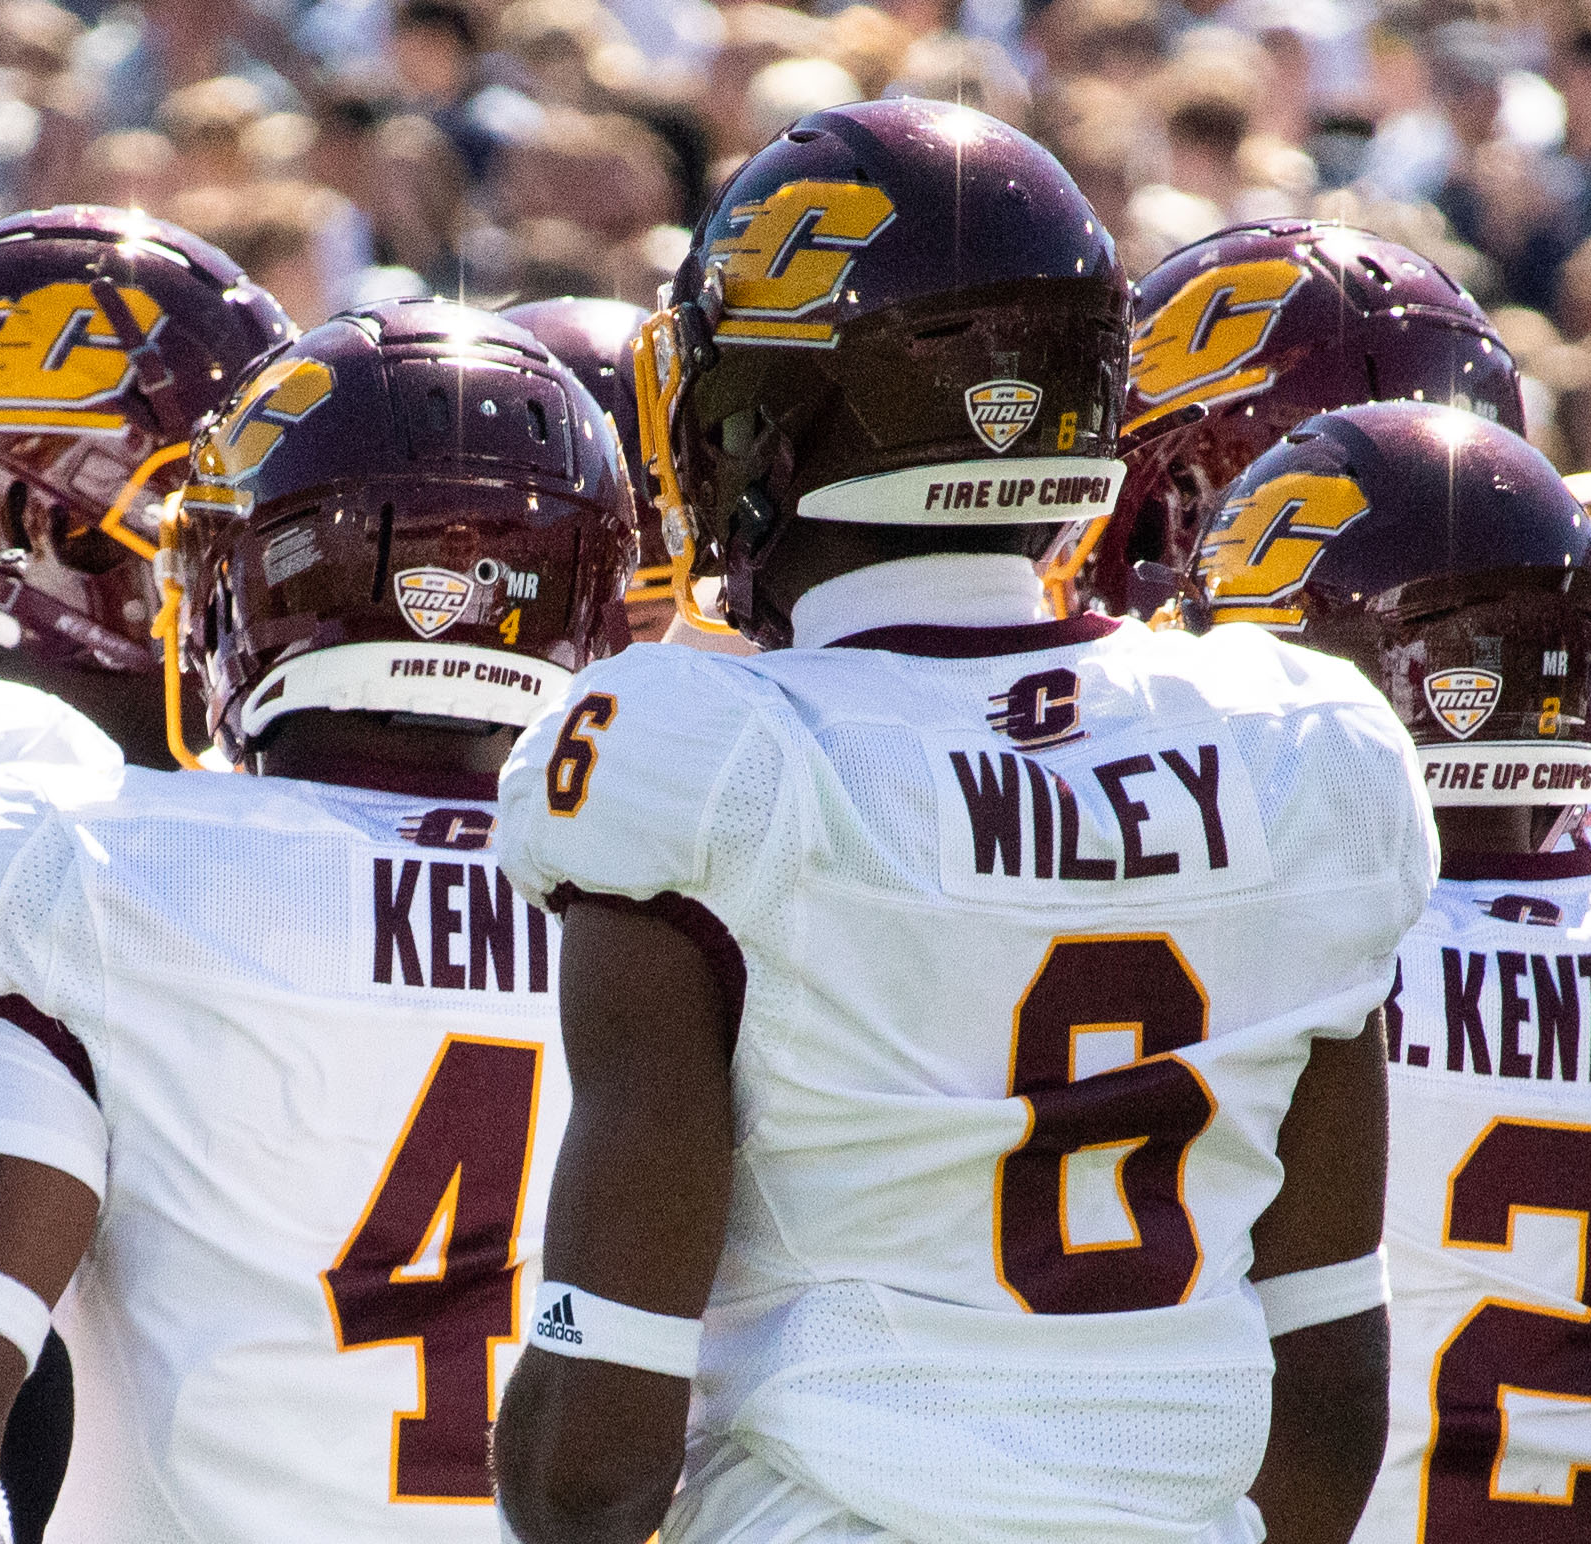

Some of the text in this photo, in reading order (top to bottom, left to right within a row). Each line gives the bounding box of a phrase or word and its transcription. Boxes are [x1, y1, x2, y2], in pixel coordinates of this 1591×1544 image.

[975, 404, 1035, 421] MAC
[925, 480, 993, 510] FIRE
[997, 478, 1035, 506] UP
[506, 572, 539, 600] MR
[401, 589, 463, 611] MAC
[499, 608, 522, 645] 4
[390, 659, 438, 677] FIRE
[442, 660, 471, 678] UP
[1542, 650, 1568, 676] MR
[1434, 690, 1494, 709] MAC
[1538, 697, 1561, 734] 2
[544, 692, 619, 817] 6
[1424, 763, 1489, 790] FIRE
[1492, 763, 1530, 790] UP
[949, 744, 1229, 881] WILEY
[319, 1032, 545, 1504] 4
[536, 1321, 584, 1345] adidas
